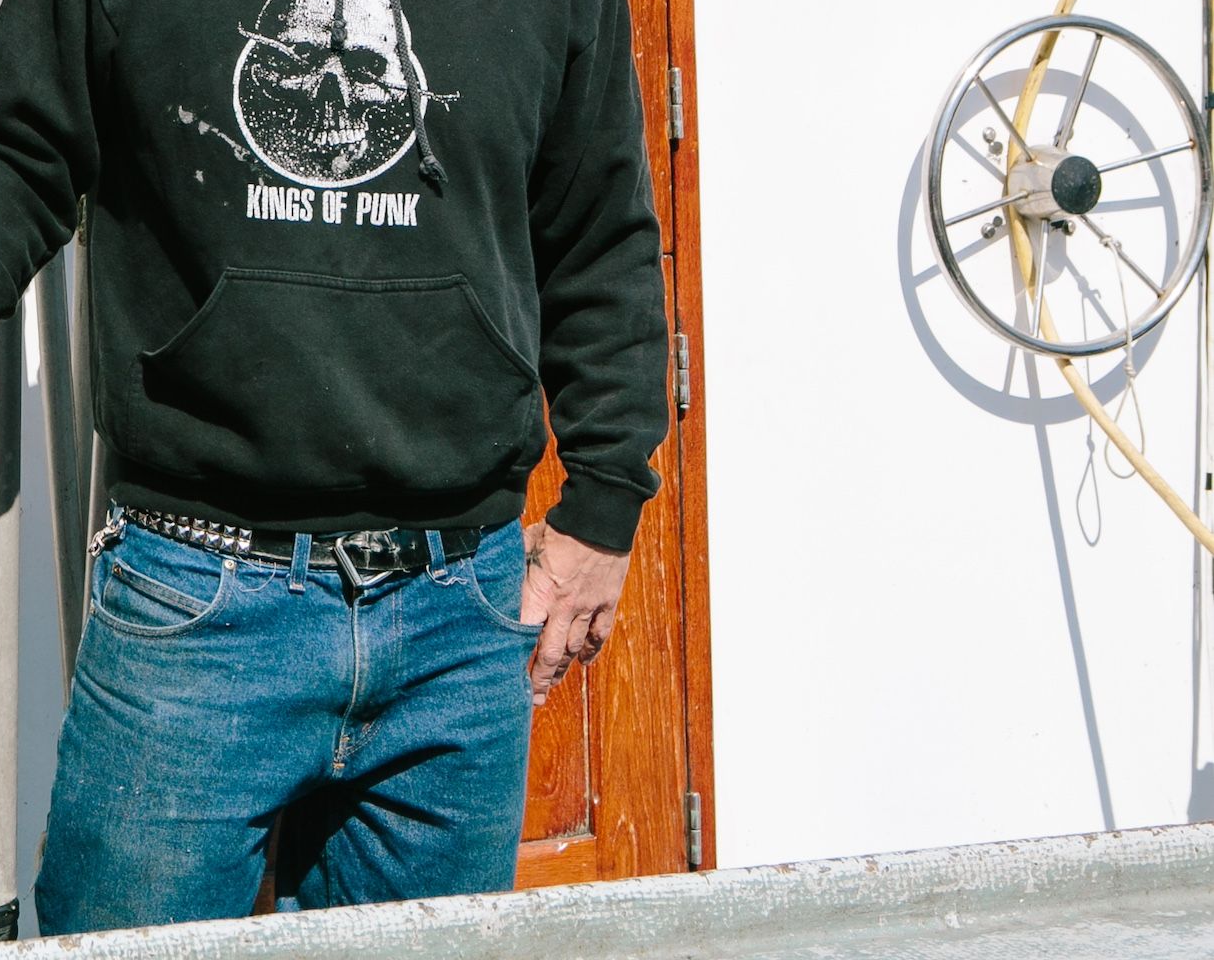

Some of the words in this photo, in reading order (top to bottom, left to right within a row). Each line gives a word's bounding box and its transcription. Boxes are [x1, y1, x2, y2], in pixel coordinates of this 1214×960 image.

[246, 184, 314, 221] KINGS
[322, 191, 347, 224] OF
[356, 192, 420, 226] PUNK
